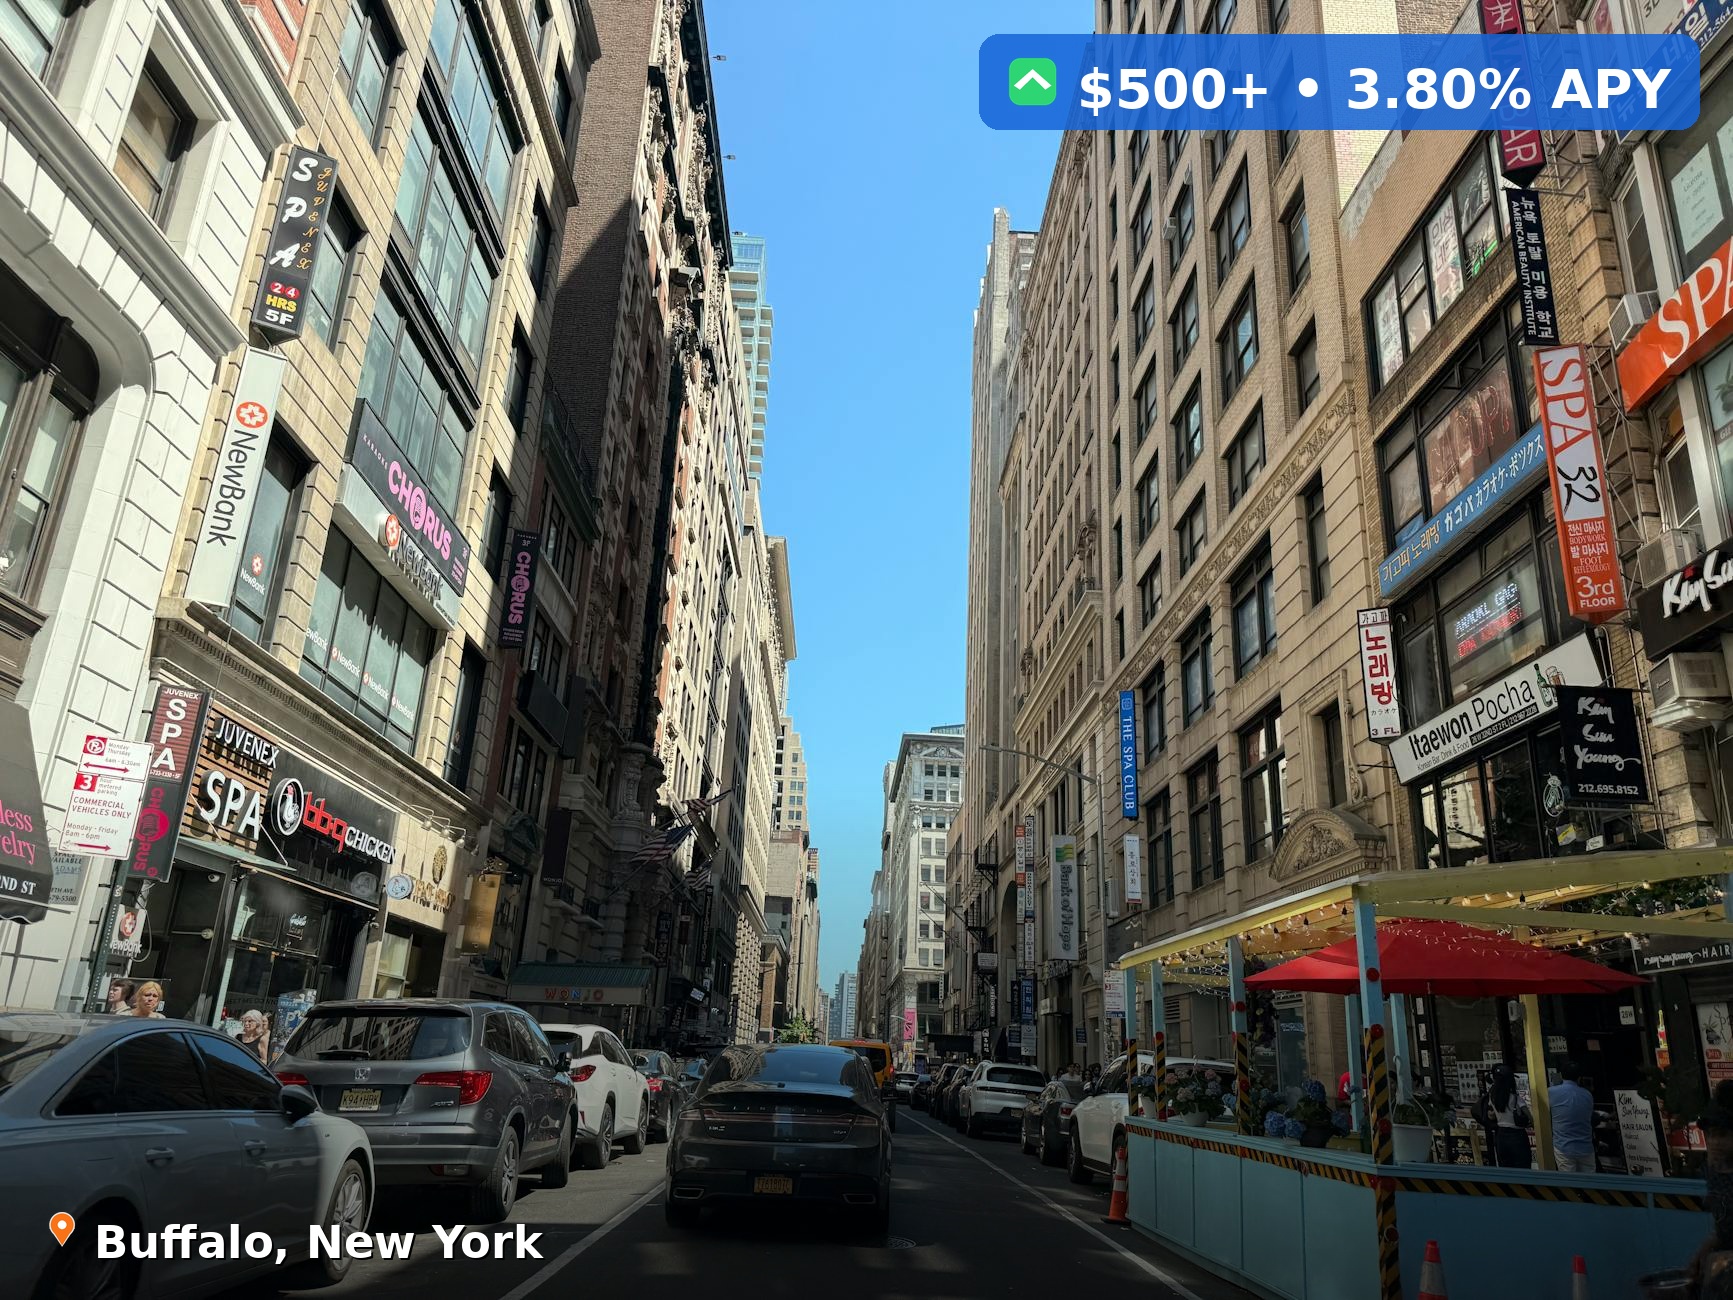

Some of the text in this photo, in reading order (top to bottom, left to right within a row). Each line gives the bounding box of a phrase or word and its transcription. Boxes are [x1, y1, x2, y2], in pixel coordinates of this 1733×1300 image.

[269, 157, 318, 269] SPA
[296, 167, 333, 270] JUVENEX
[1512, 200, 1537, 336] AMERICAN BEAUTY INSTITUTE
[272, 282, 298, 298] 24
[266, 294, 297, 313] HRS
[265, 310, 294, 325] 5F
[1540, 358, 1593, 457] SPA
[206, 429, 260, 547] NewBank
[388, 460, 452, 561] CHORUS
[1583, 520, 1606, 534] 마사지
[1569, 533, 1607, 545] BODYWORK
[1582, 542, 1609, 556] 마사지
[1580, 556, 1602, 566] FOOT
[508, 551, 532, 625] CHORUS
[1577, 575, 1615, 598] 3rd
[1580, 596, 1616, 608] FLOOR
[305, 628, 328, 652] ewBank
[1365, 629, 1392, 705] 노래방
[164, 687, 199, 701] JUVENEX
[1408, 679, 1536, 761] Itaewon Pocha
[1577, 697, 1614, 724] Kim
[152, 698, 188, 772] SPA
[1384, 727, 1400, 735] FL.
[1582, 724, 1614, 743] Sun
[216, 717, 279, 769] JUVENEX
[1123, 716, 1135, 810] THE SPA CLUB
[1574, 745, 1641, 771] Young
[79, 775, 93, 790] 3
[98, 783, 122, 791] metered
[1577, 783, 1639, 795] 212.695.8152
[72, 805, 132, 819] VEHICLES ONLY
[73, 796, 125, 809] COMMERCIAL
[201, 770, 261, 841] SPA
[66, 822, 93, 832] Monday
[98, 826, 119, 835] Friday
[86, 832, 101, 840] 6pm
[0, 831, 36, 865] elry
[345, 826, 397, 864] CHICKEN
[0, 875, 36, 895] ND ST
[1059, 864, 1073, 951] Bank of Hope
[1702, 944, 1730, 959] HAIR
[545, 988, 604, 1001] WONJO
